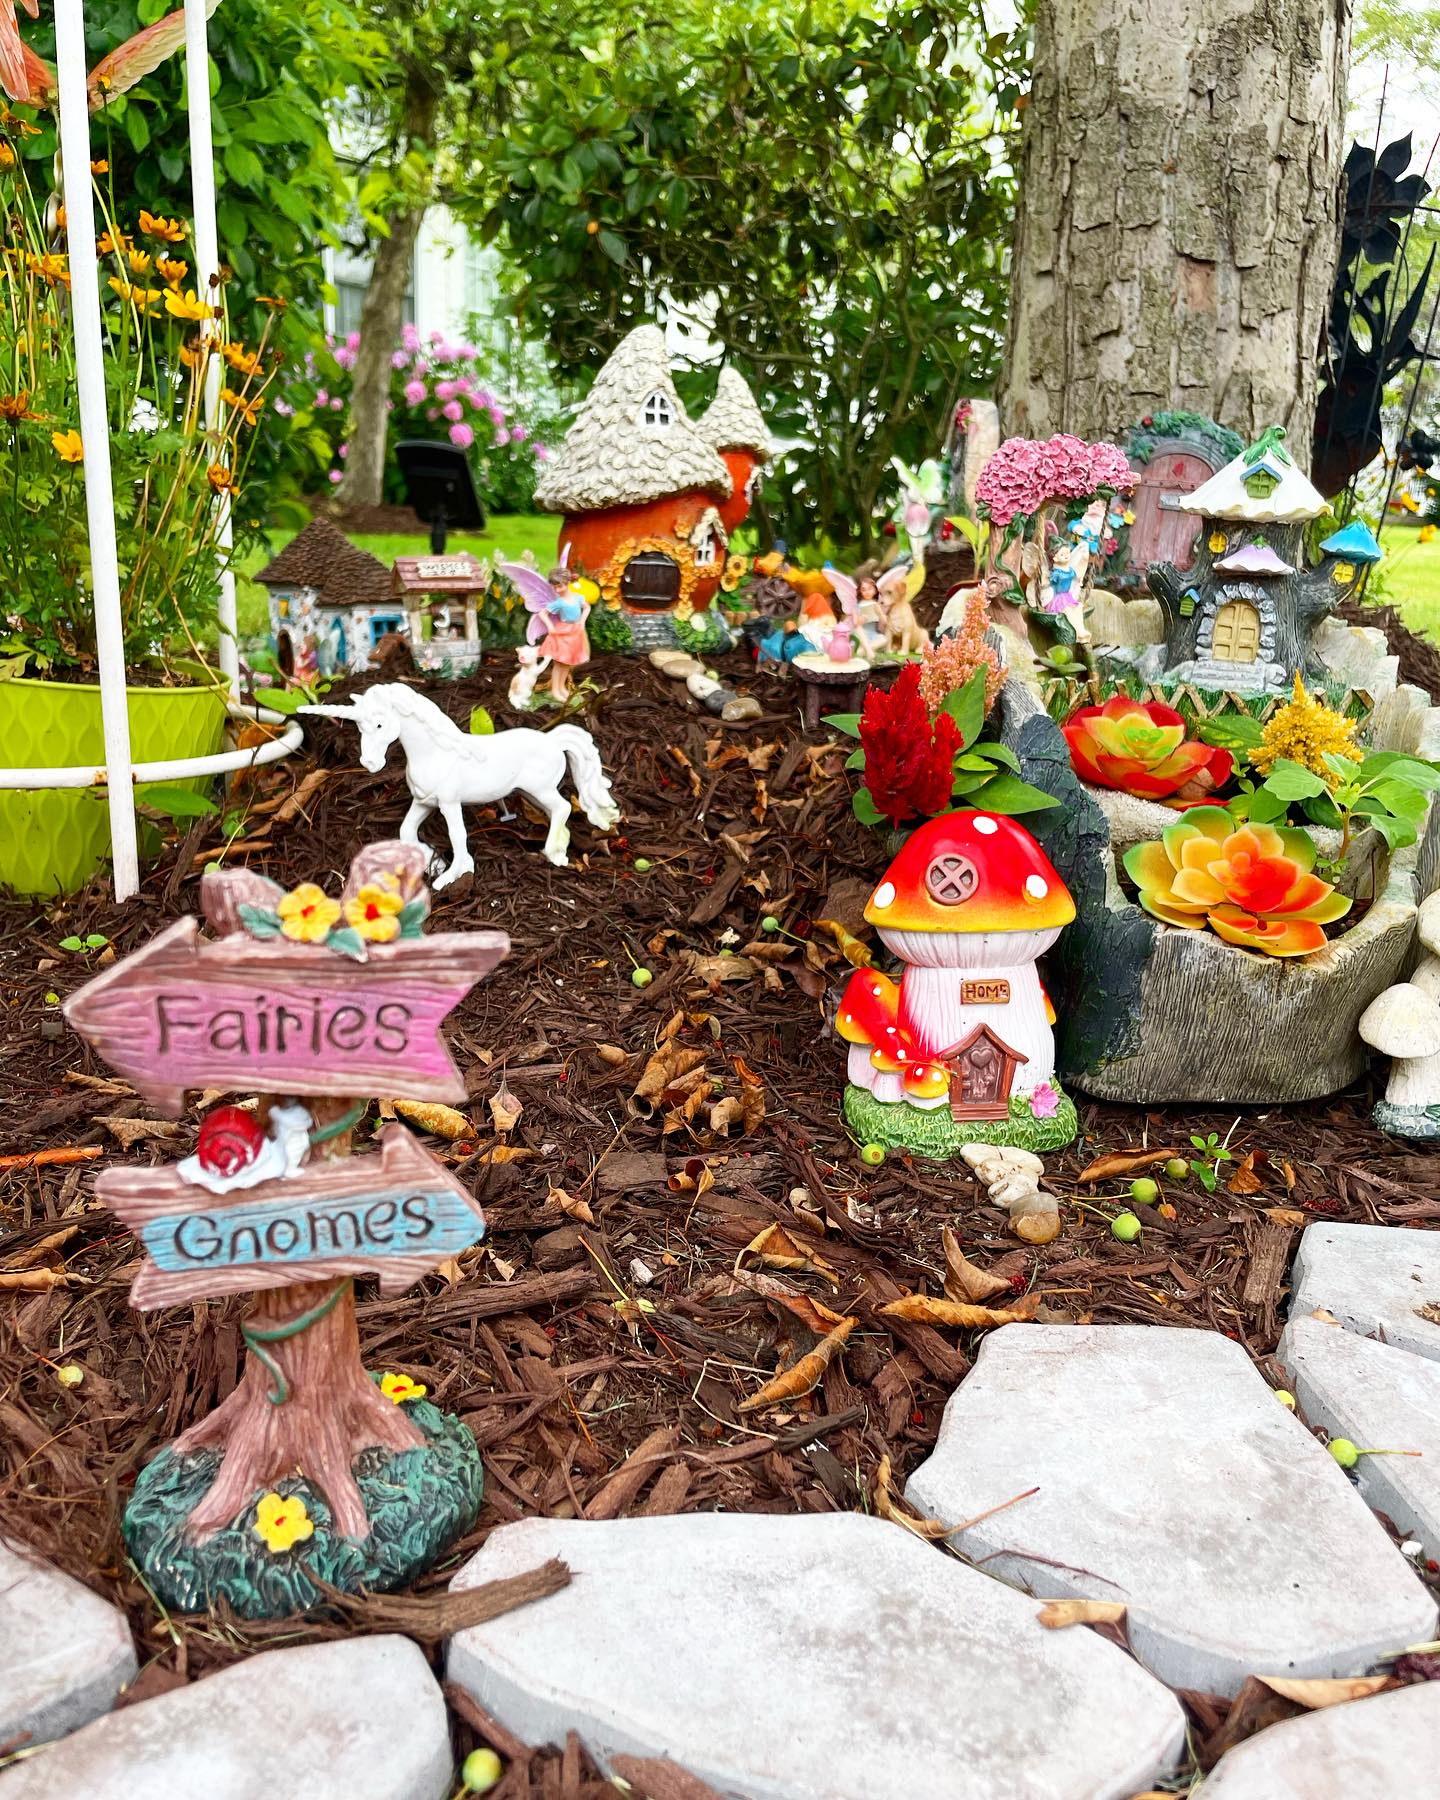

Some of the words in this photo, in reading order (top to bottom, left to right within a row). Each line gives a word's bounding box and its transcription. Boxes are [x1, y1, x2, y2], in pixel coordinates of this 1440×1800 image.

[965, 983, 1009, 999] HOME
[155, 994, 412, 1056] Fairies
[173, 1196, 435, 1263] Gnomes
